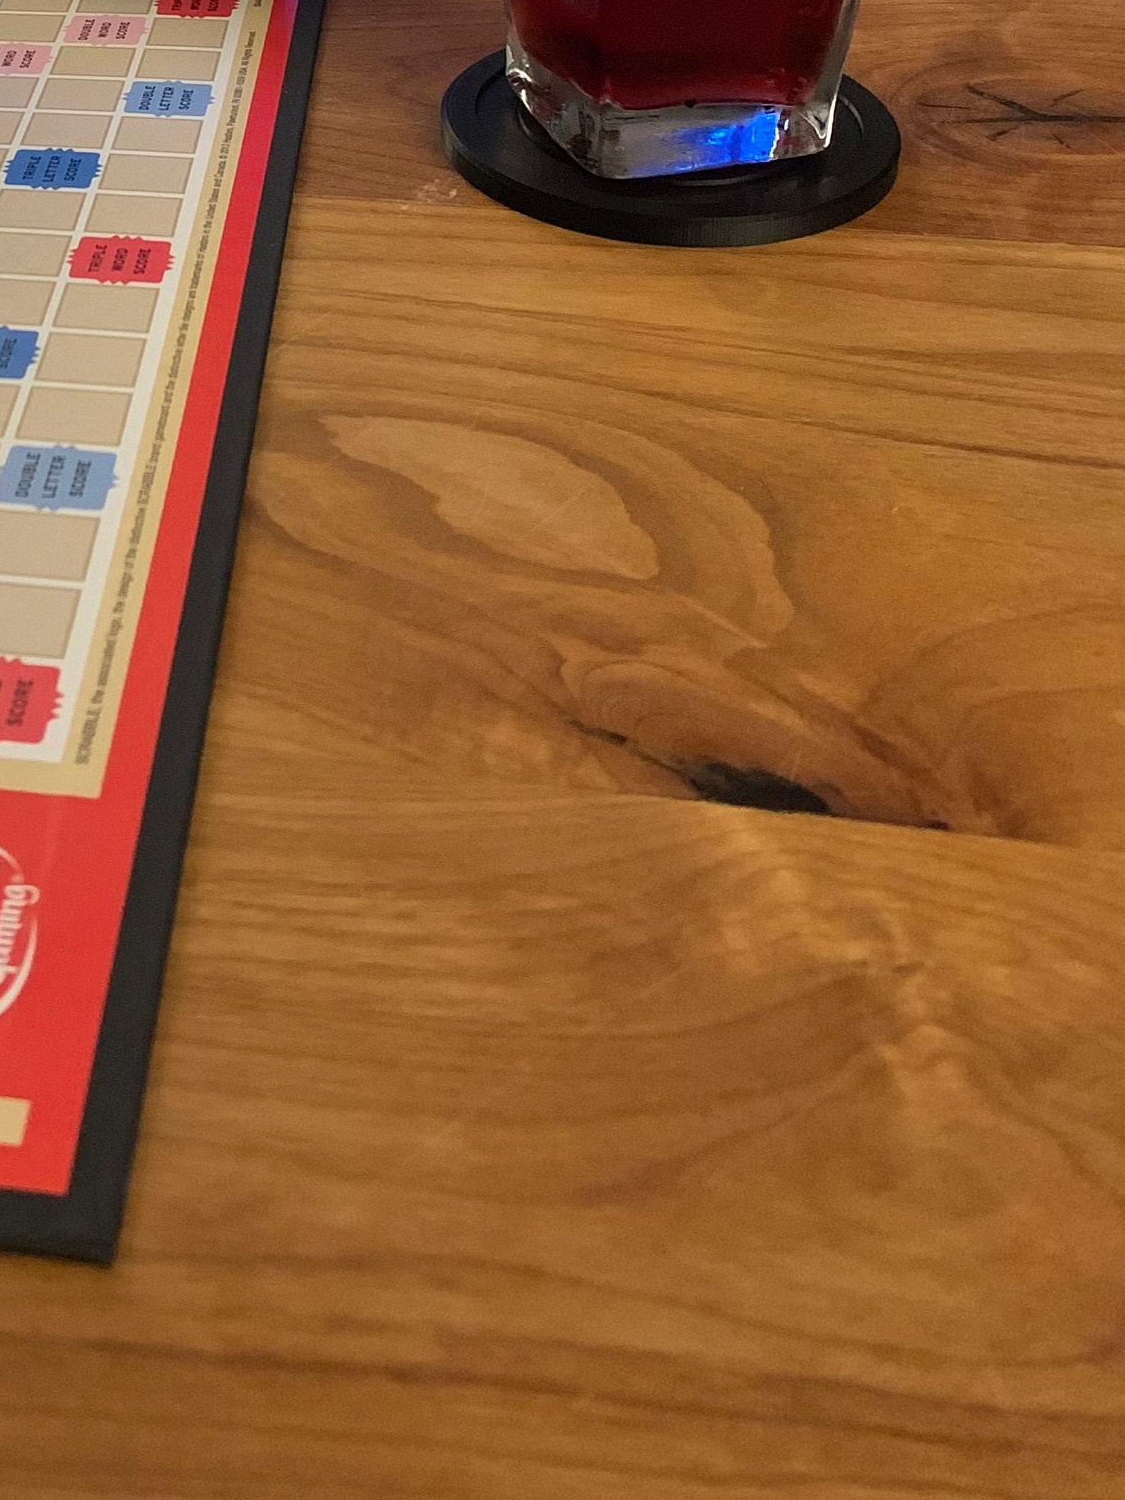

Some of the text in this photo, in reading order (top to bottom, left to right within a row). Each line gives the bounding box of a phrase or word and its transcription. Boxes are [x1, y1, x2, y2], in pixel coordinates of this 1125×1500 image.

[77, 18, 96, 39] DOUBLE
[97, 22, 113, 37] WORD
[114, 22, 131, 39] SCORE
[0, 50, 18, 66] WORD
[18, 50, 37, 68] SCORE
[138, 86, 156, 110] DOUBLE
[157, 87, 175, 110] LETTER
[178, 89, 194, 109] SCORE
[21, 156, 42, 180] TRIPLE
[41, 155, 63, 182] LETTER
[63, 158, 82, 181] SCORE
[86, 244, 108, 273] TRIPLE
[110, 248, 129, 271] WORD
[132, 248, 152, 274] SCORE
[14, 453, 42, 497] DOUBLE
[40, 455, 68, 498] LETTER
[68, 461, 92, 497] SCORE
[5, 678, 35, 726] SCORE
